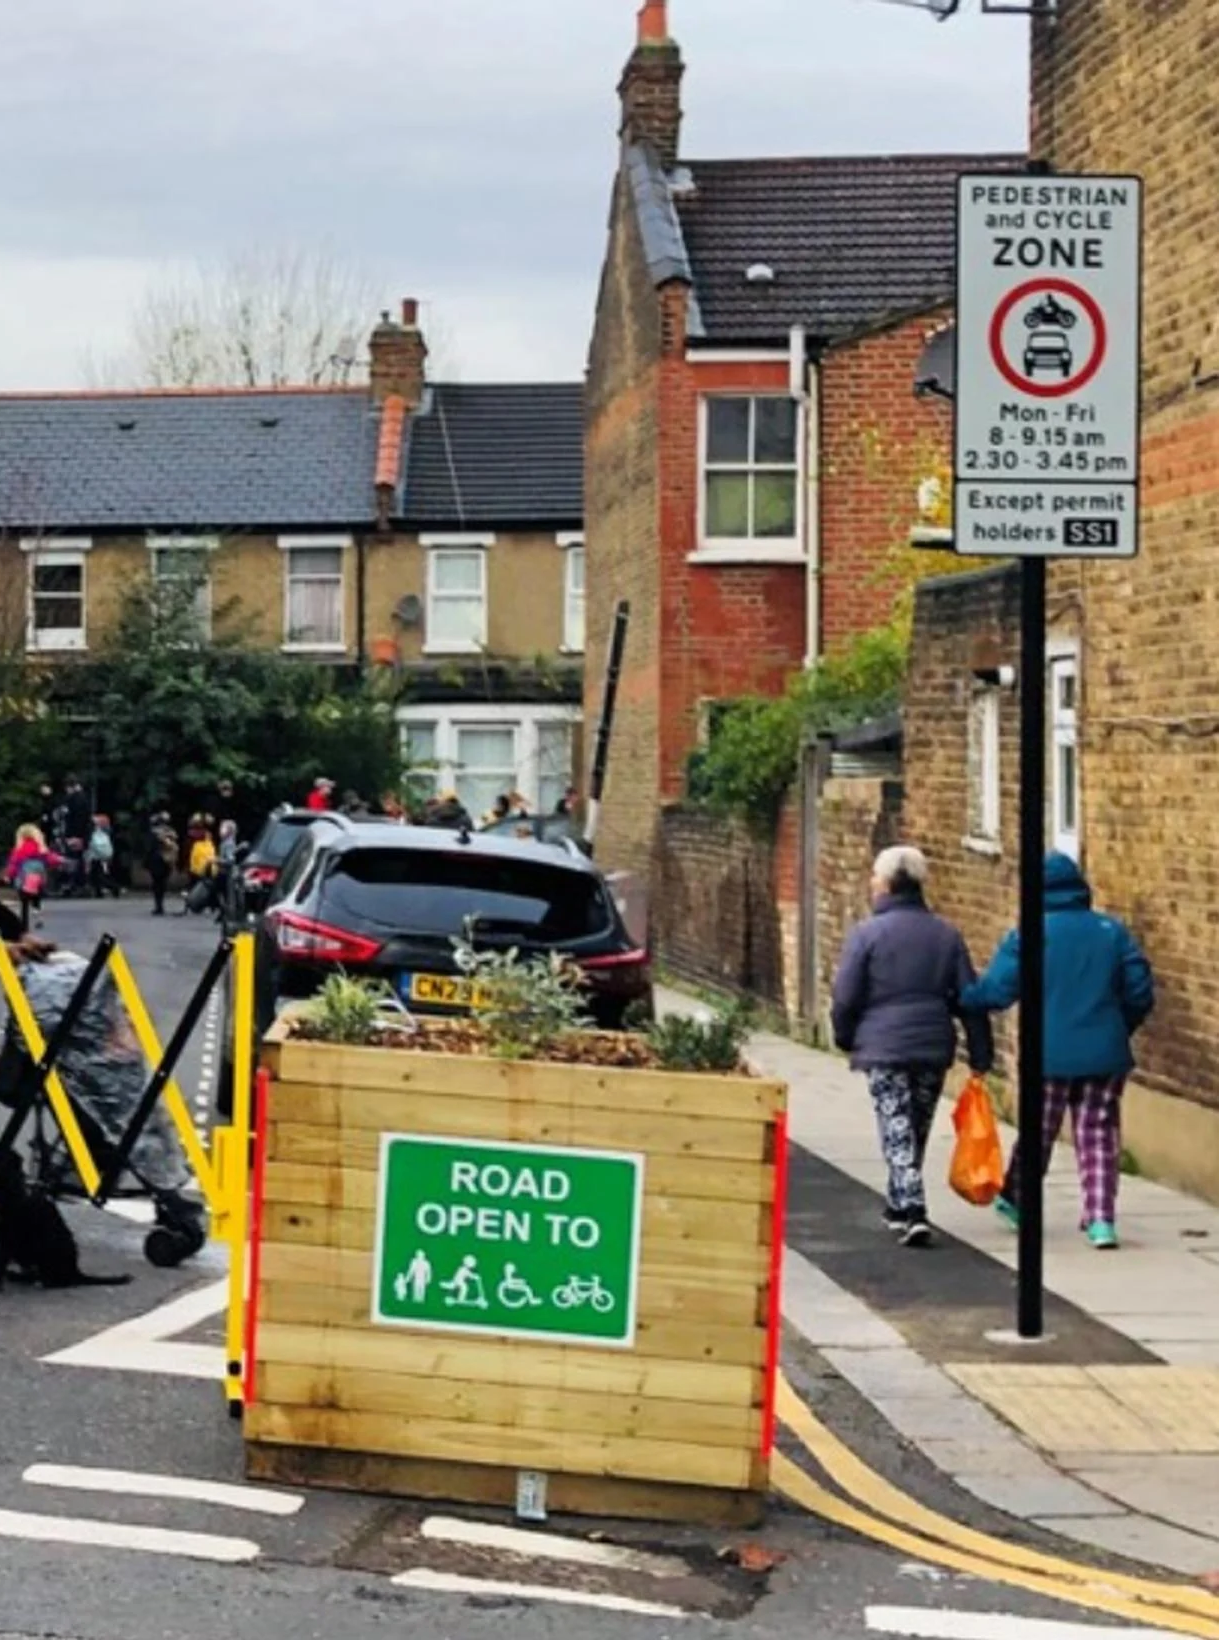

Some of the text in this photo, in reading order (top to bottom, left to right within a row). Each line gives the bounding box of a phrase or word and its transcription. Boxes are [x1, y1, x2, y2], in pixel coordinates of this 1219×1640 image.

[971, 186, 1128, 206] PEDESTRIAN
[985, 211, 1113, 230] and CYCLE
[992, 238, 1104, 268] ZONE
[999, 404, 1047, 422] Mon
[1066, 404, 1096, 422] Fri
[989, 427, 1003, 446] 8
[1021, 428, 1067, 446] 9.15
[1072, 432, 1105, 446] am
[965, 451, 1019, 470] 2.30
[1036, 452, 1089, 470] 3.45
[1094, 457, 1127, 473] pm
[968, 490, 1125, 513] Except permit
[973, 522, 1113, 543] holders SS1
[450, 1161, 570, 1201] ROAD
[416, 1202, 600, 1248] OPEN TO
